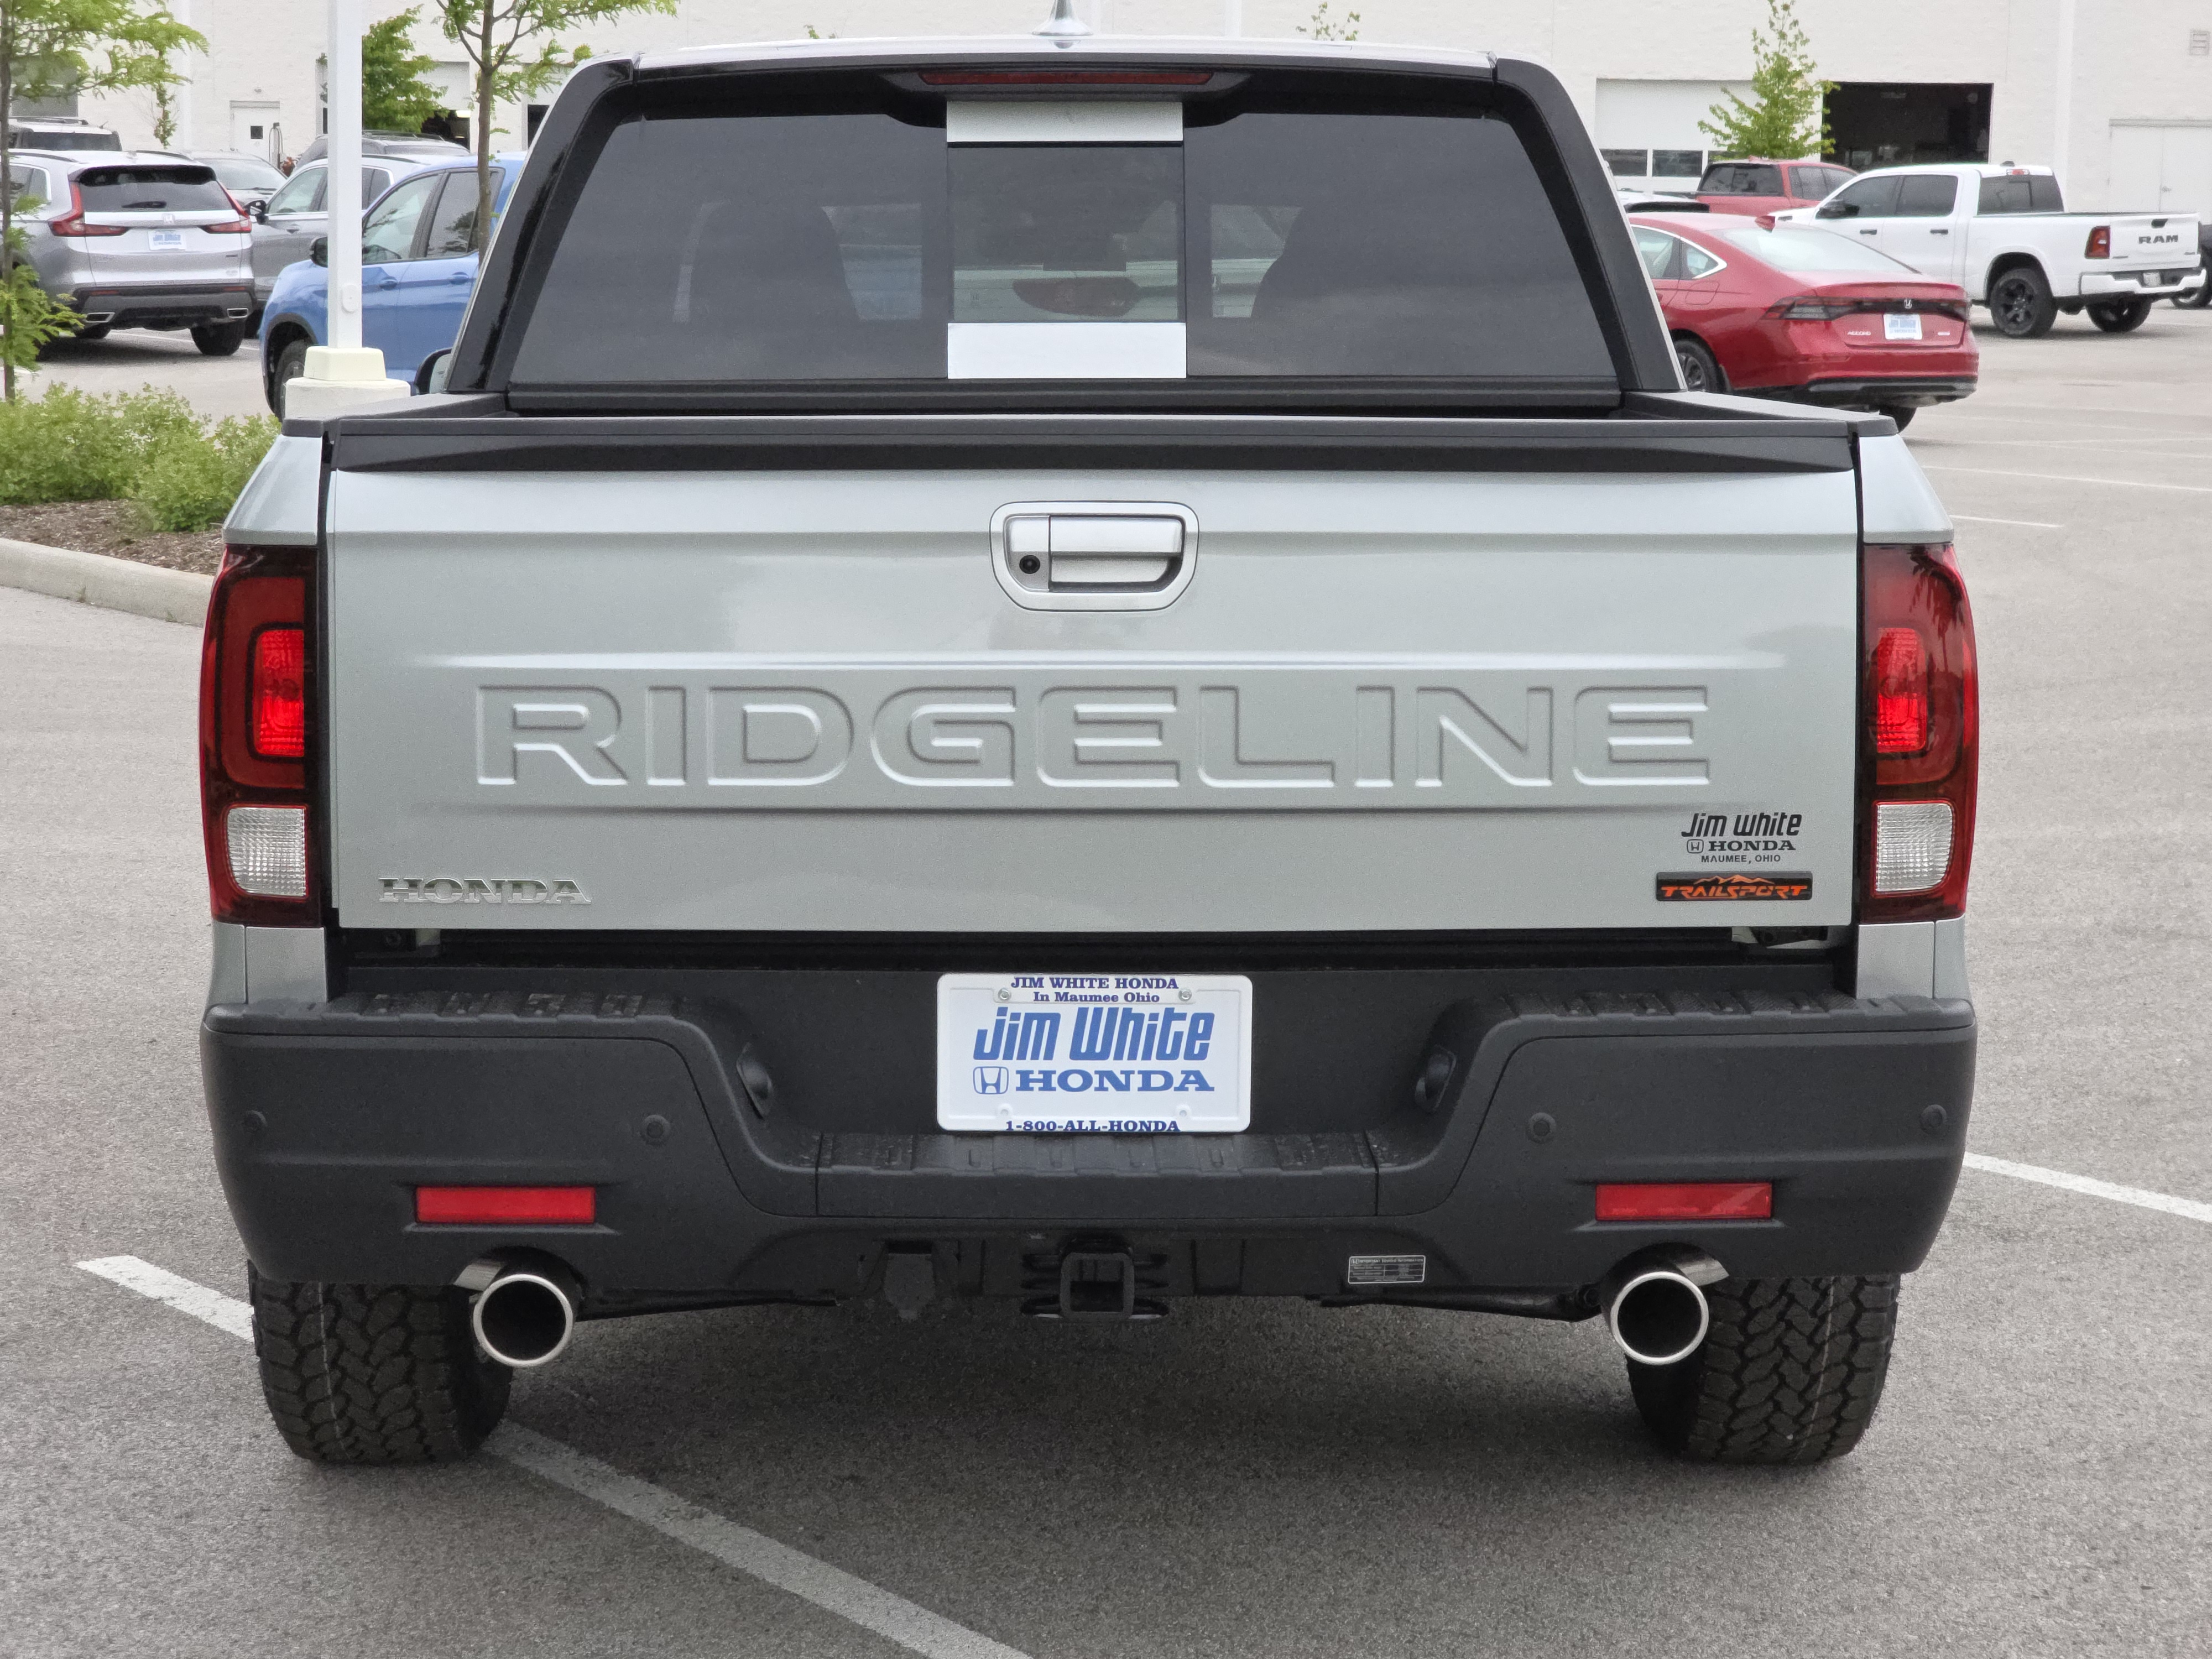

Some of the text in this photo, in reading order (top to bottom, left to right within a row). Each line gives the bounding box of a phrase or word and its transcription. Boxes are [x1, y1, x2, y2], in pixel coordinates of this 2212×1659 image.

[2138, 235, 2178, 244] RAM
[476, 684, 1710, 786] RIDGELINE
[1681, 813, 1727, 837] Jim
[1708, 840, 1796, 851] HONDA
[1701, 855, 1751, 864] MAUMEE,
[378, 878, 592, 904] HONDA
[1661, 886, 1808, 899] TRAILSPORT
[1011, 977, 1179, 989] JIM WHITE HONDA
[1034, 992, 1160, 1002] In Maumee Ohio
[1069, 1006, 1215, 1061] White
[1015, 1069, 1215, 1092] HONDA
[1005, 1120, 1181, 1131] 1-800-ALL-HONDA
